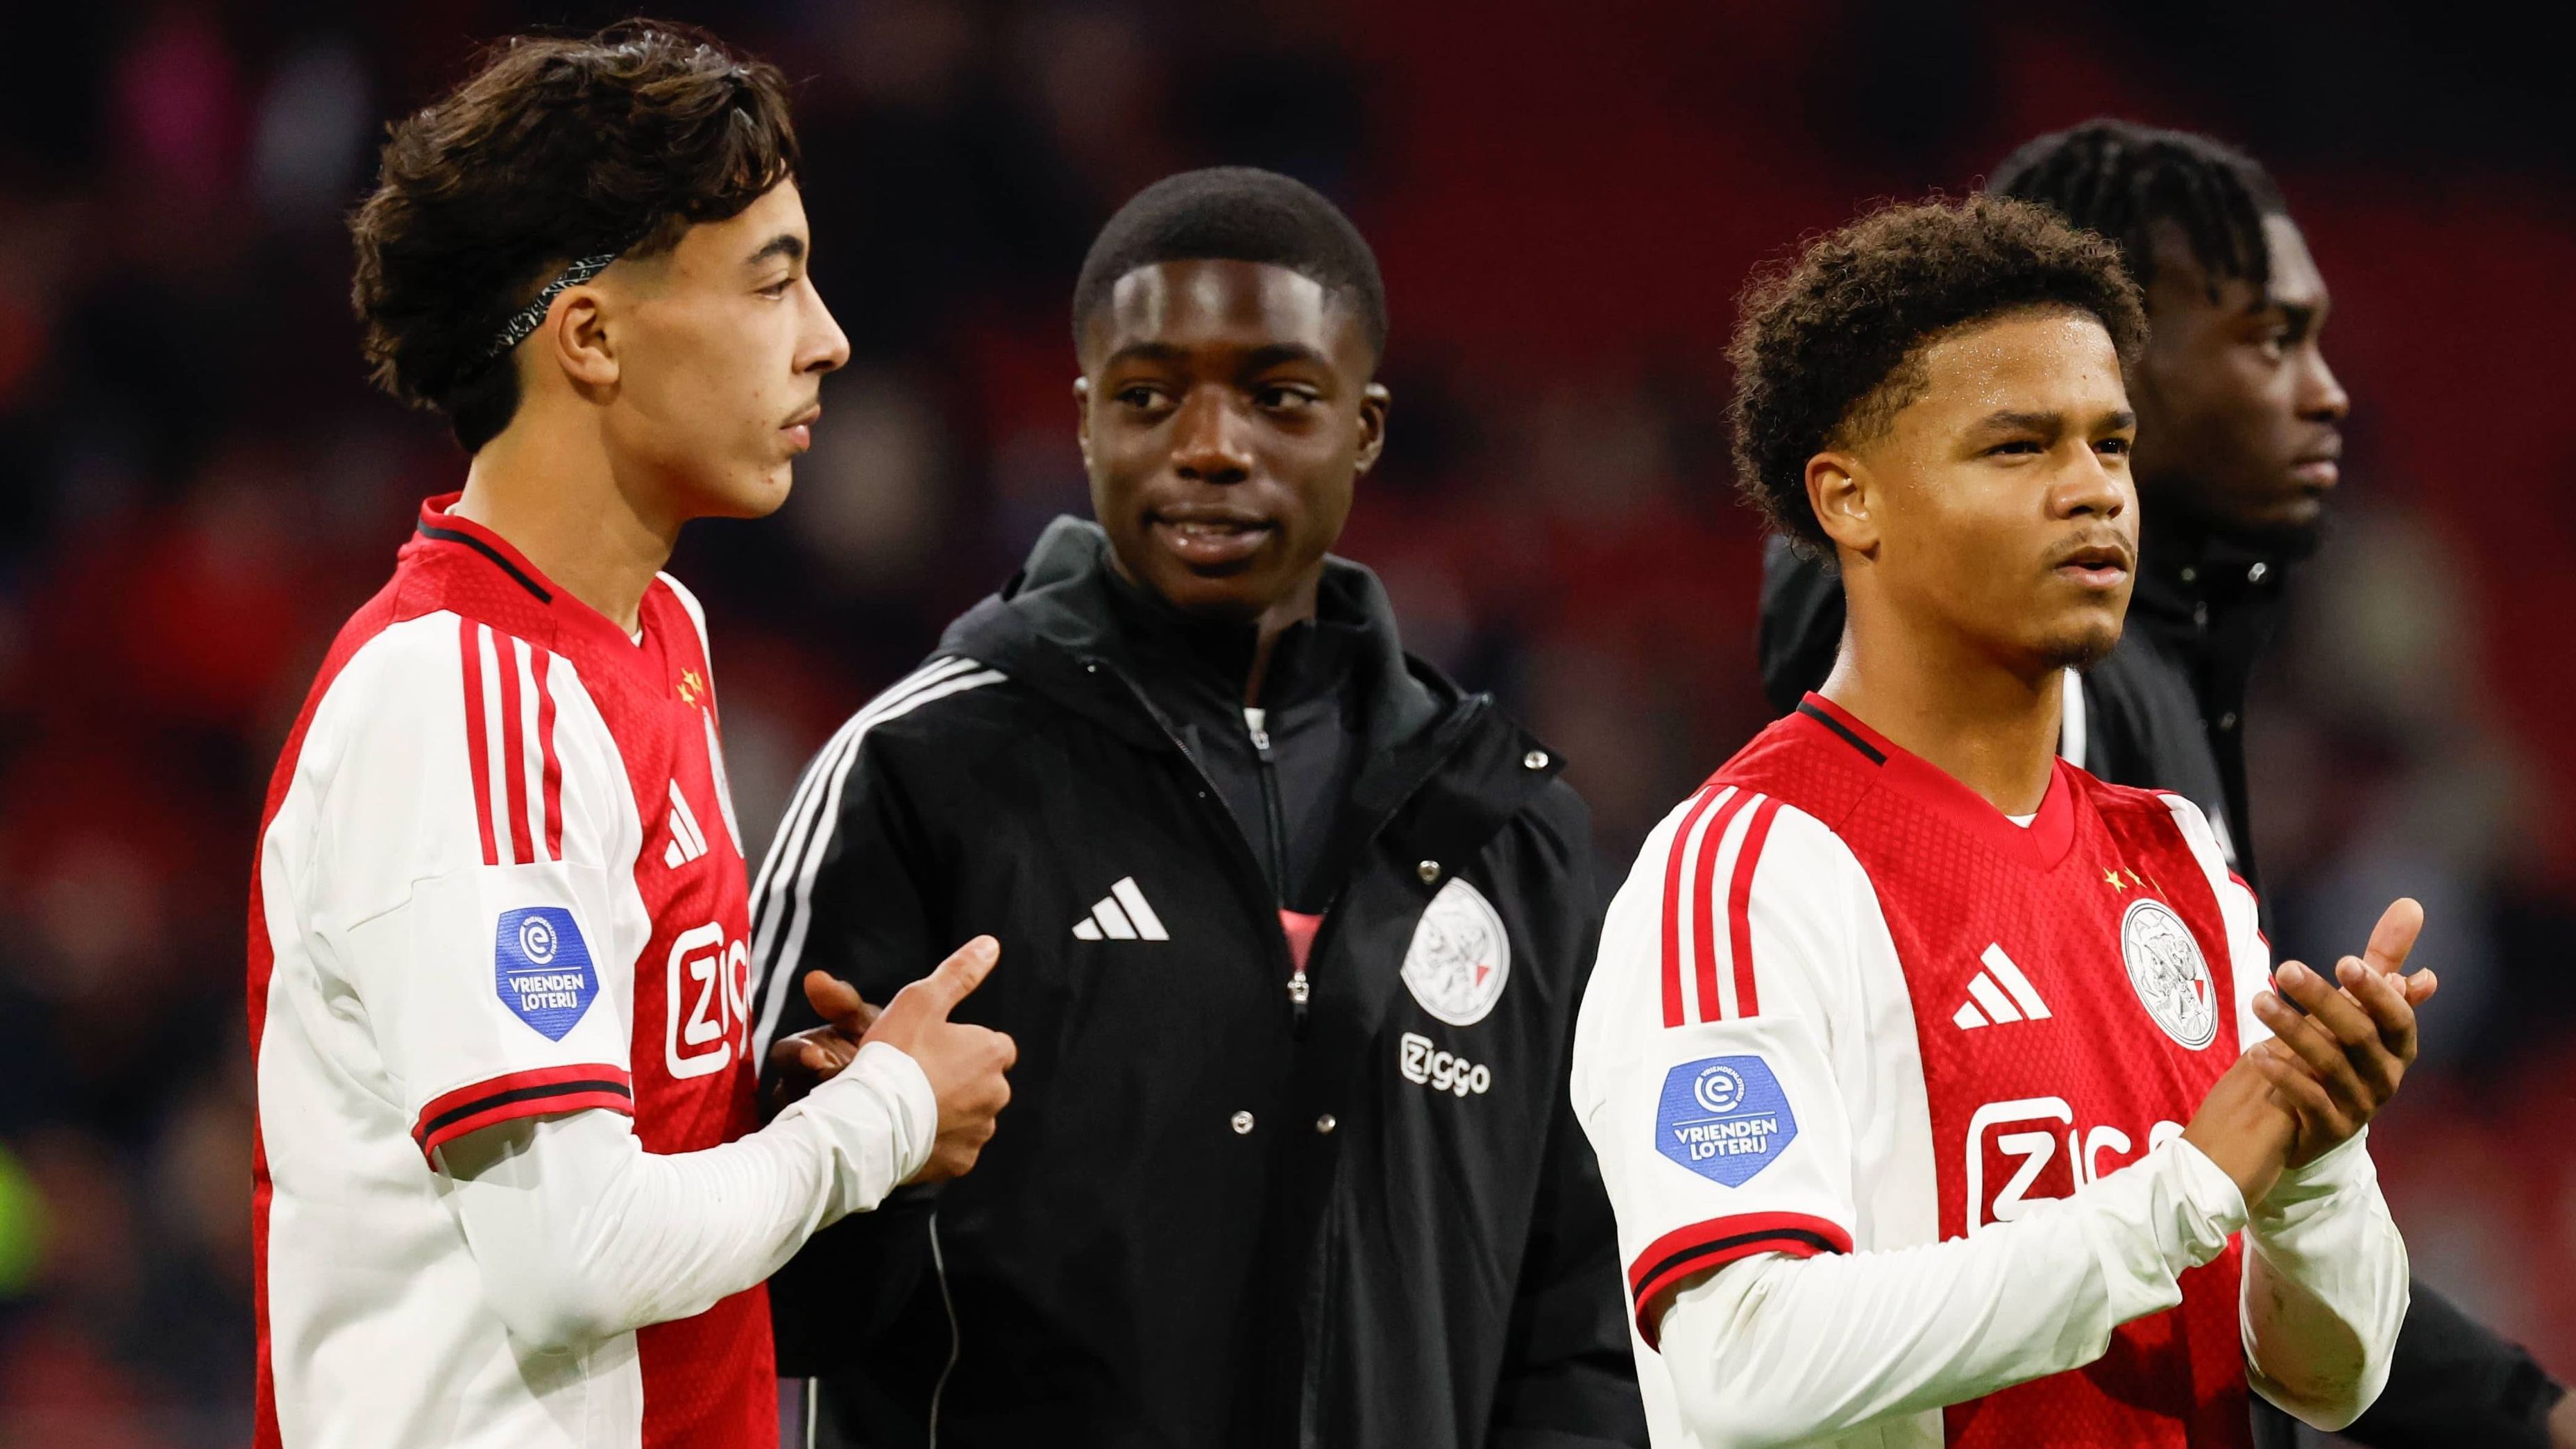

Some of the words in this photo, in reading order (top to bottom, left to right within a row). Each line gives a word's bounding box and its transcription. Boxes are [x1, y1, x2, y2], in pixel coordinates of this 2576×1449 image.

[509, 974, 584, 993] VRIENDEN
[520, 992, 578, 1012] LOTERIJ
[1674, 1118, 1778, 1144] VRIENDEN
[1690, 1136, 1768, 1161] LOTERIJ
